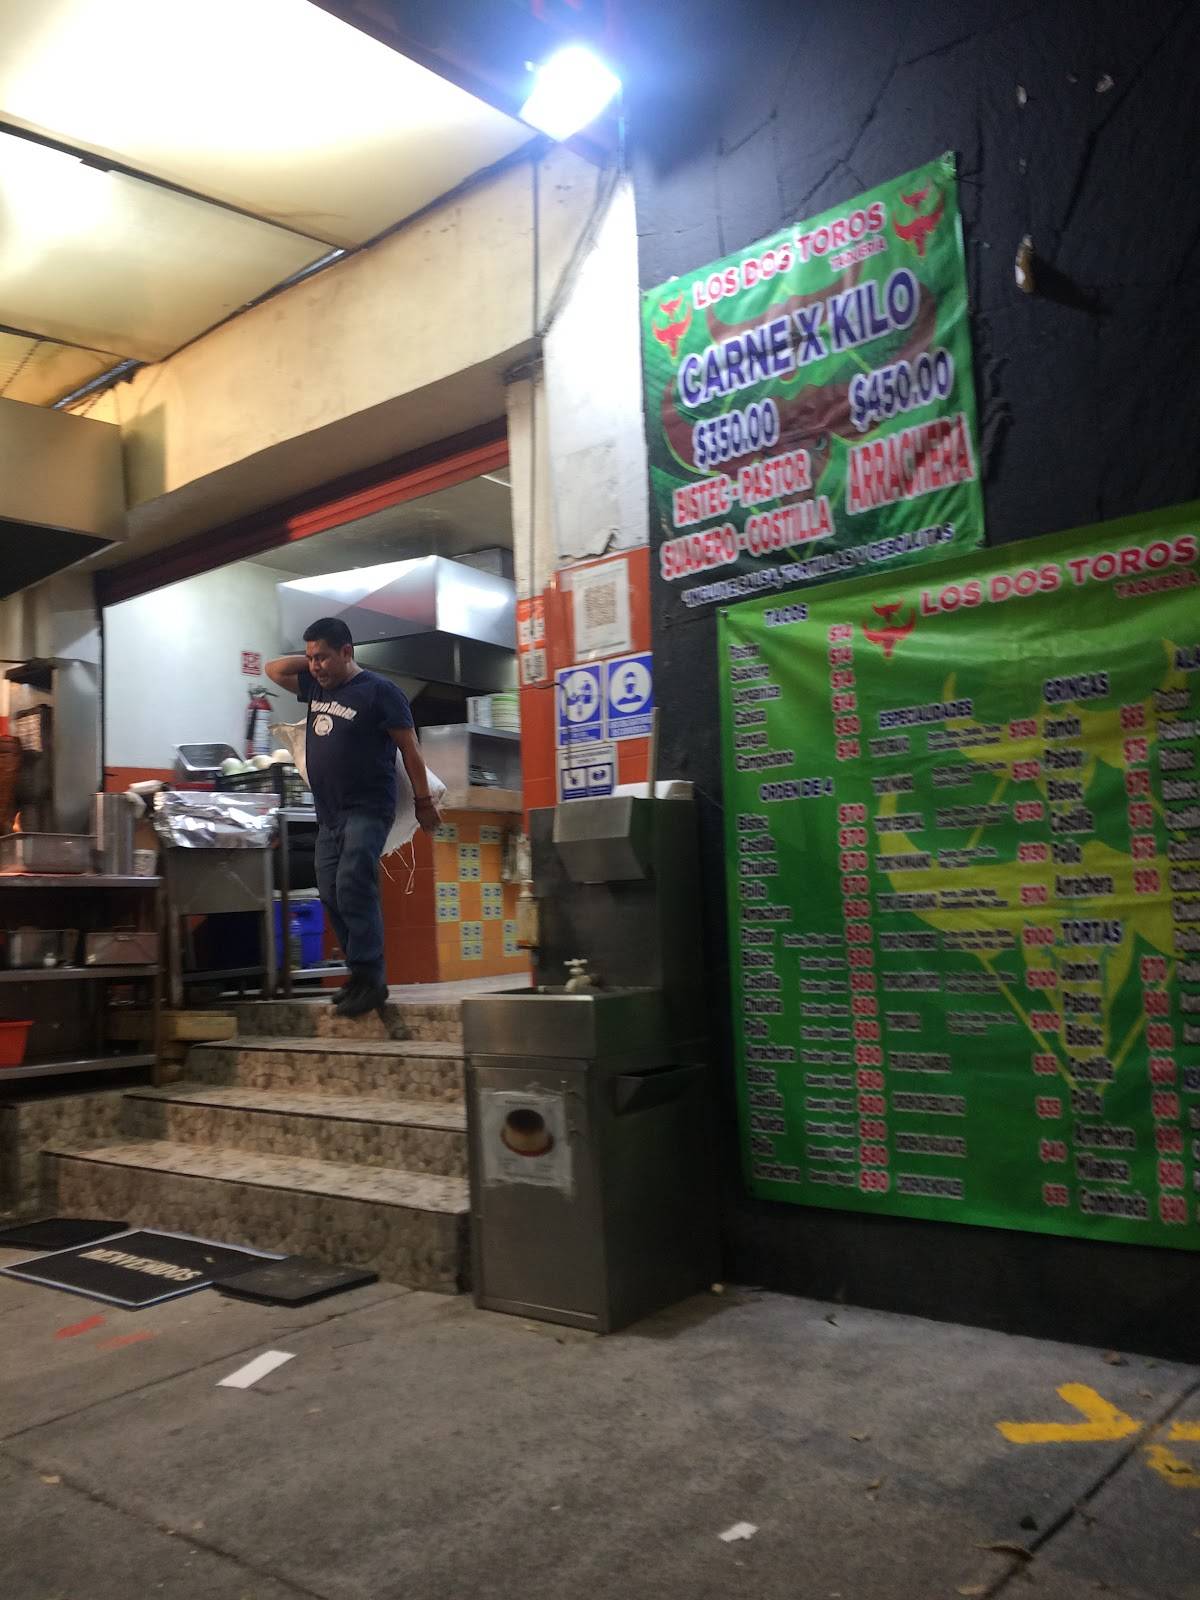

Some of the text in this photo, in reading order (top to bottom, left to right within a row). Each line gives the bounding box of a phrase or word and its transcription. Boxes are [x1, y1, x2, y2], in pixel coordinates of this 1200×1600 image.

[692, 202, 887, 310] LOS DOS TOROS
[678, 267, 921, 408] CARNE X KILO
[849, 348, 953, 432] $450.00
[673, 473, 732, 528] BISTEC
[739, 448, 813, 508] PASTOR
[847, 412, 975, 515] ARRACHERA
[660, 522, 740, 580] SUADERO
[745, 494, 836, 557] COSTILLA
[920, 535, 1199, 616] LOS DOS TOROS
[764, 603, 809, 628] TACOS
[1042, 671, 1109, 705] GRINGAS
[759, 780, 800, 803] ORDEN
[1060, 917, 1123, 947] TORTAS
